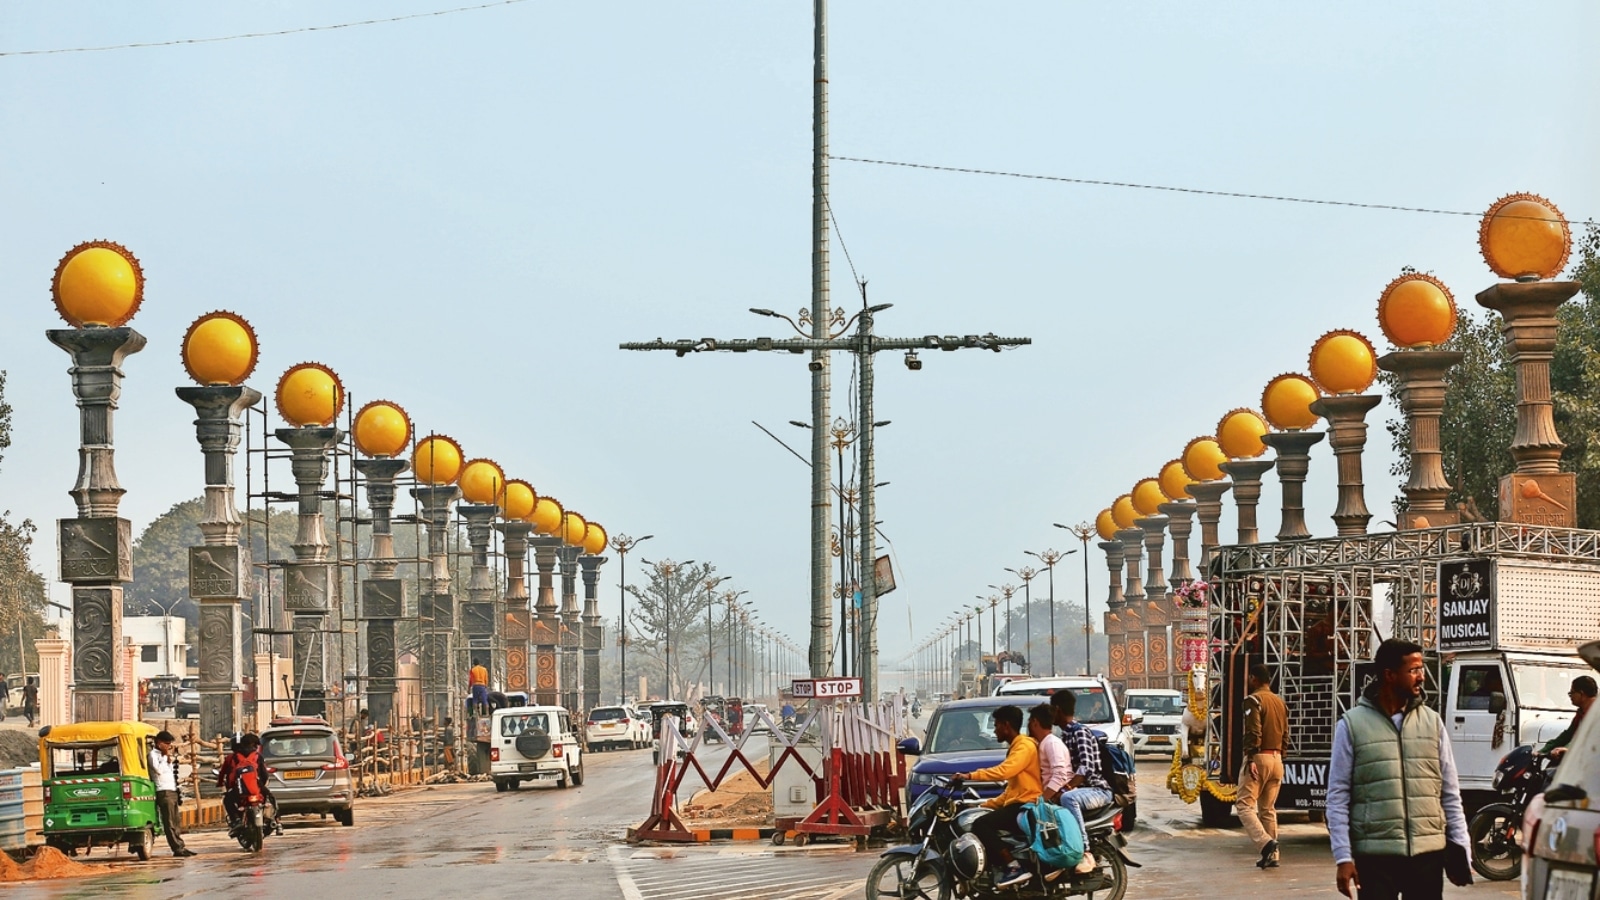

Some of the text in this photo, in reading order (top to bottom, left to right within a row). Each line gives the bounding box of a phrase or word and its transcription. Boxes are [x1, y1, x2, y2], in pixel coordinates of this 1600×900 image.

[1460, 578, 1471, 591] DJ
[1443, 599, 1489, 617] SANJAY
[1441, 622, 1490, 639] MUSICAL
[795, 684, 811, 694] STOP
[821, 682, 853, 694] STOP
